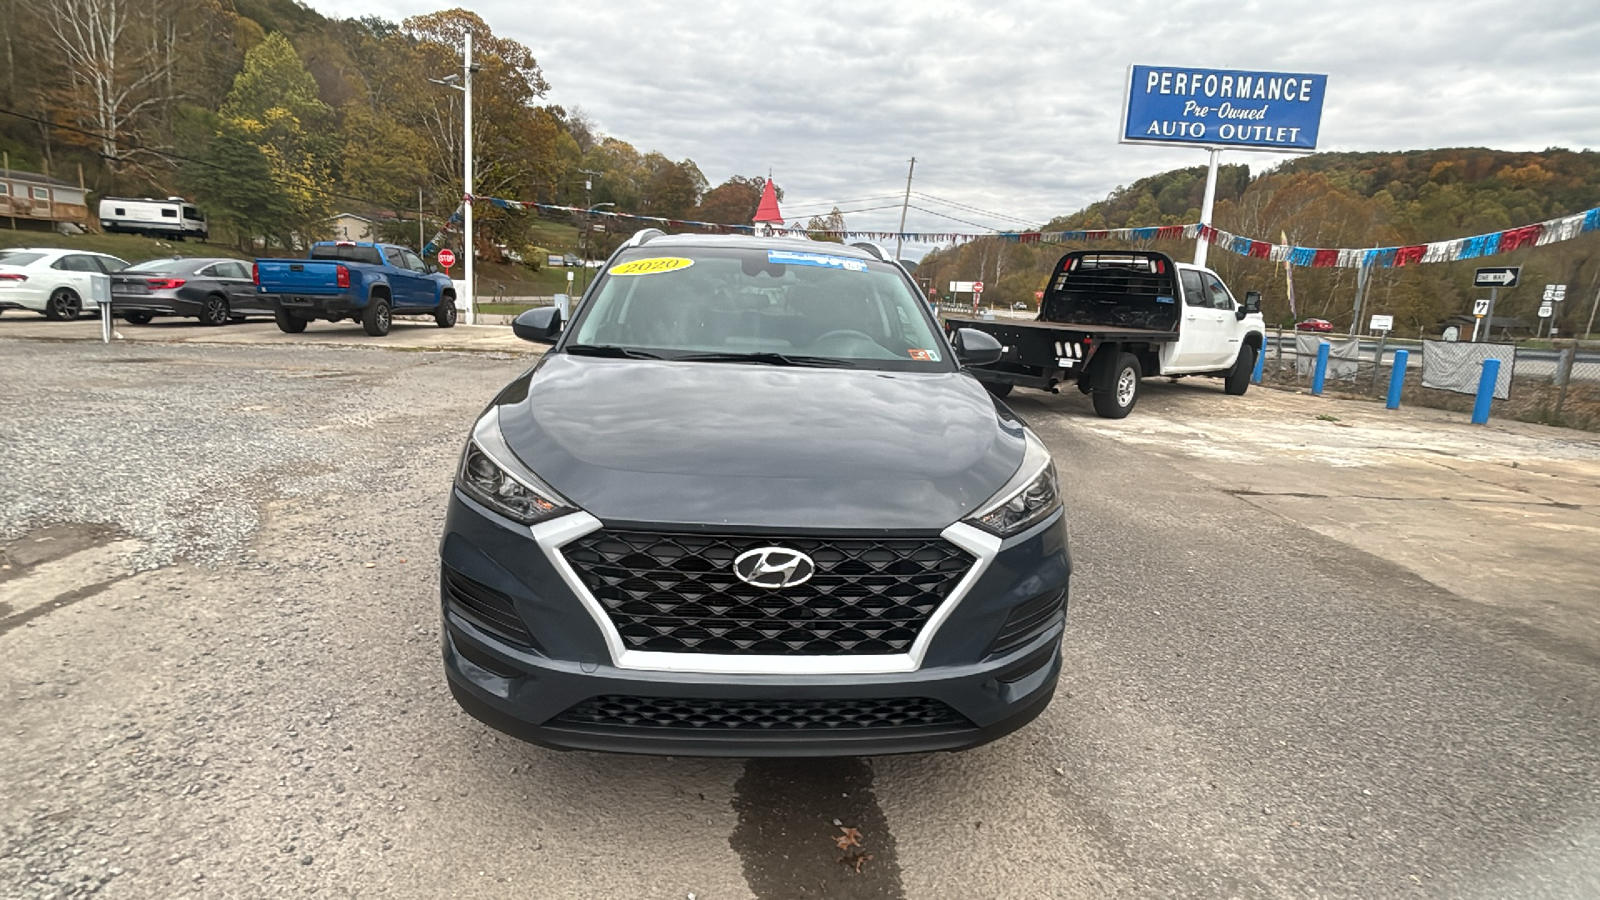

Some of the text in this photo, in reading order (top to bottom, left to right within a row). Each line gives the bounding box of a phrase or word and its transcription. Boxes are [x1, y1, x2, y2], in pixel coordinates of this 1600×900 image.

[1146, 71, 1313, 102] PERFORMANCE
[1183, 100, 1269, 120] Pre-Owned
[1146, 120, 1301, 143] AUTO OUTLET
[439, 254, 454, 262] STOP
[623, 259, 680, 274] 2020
